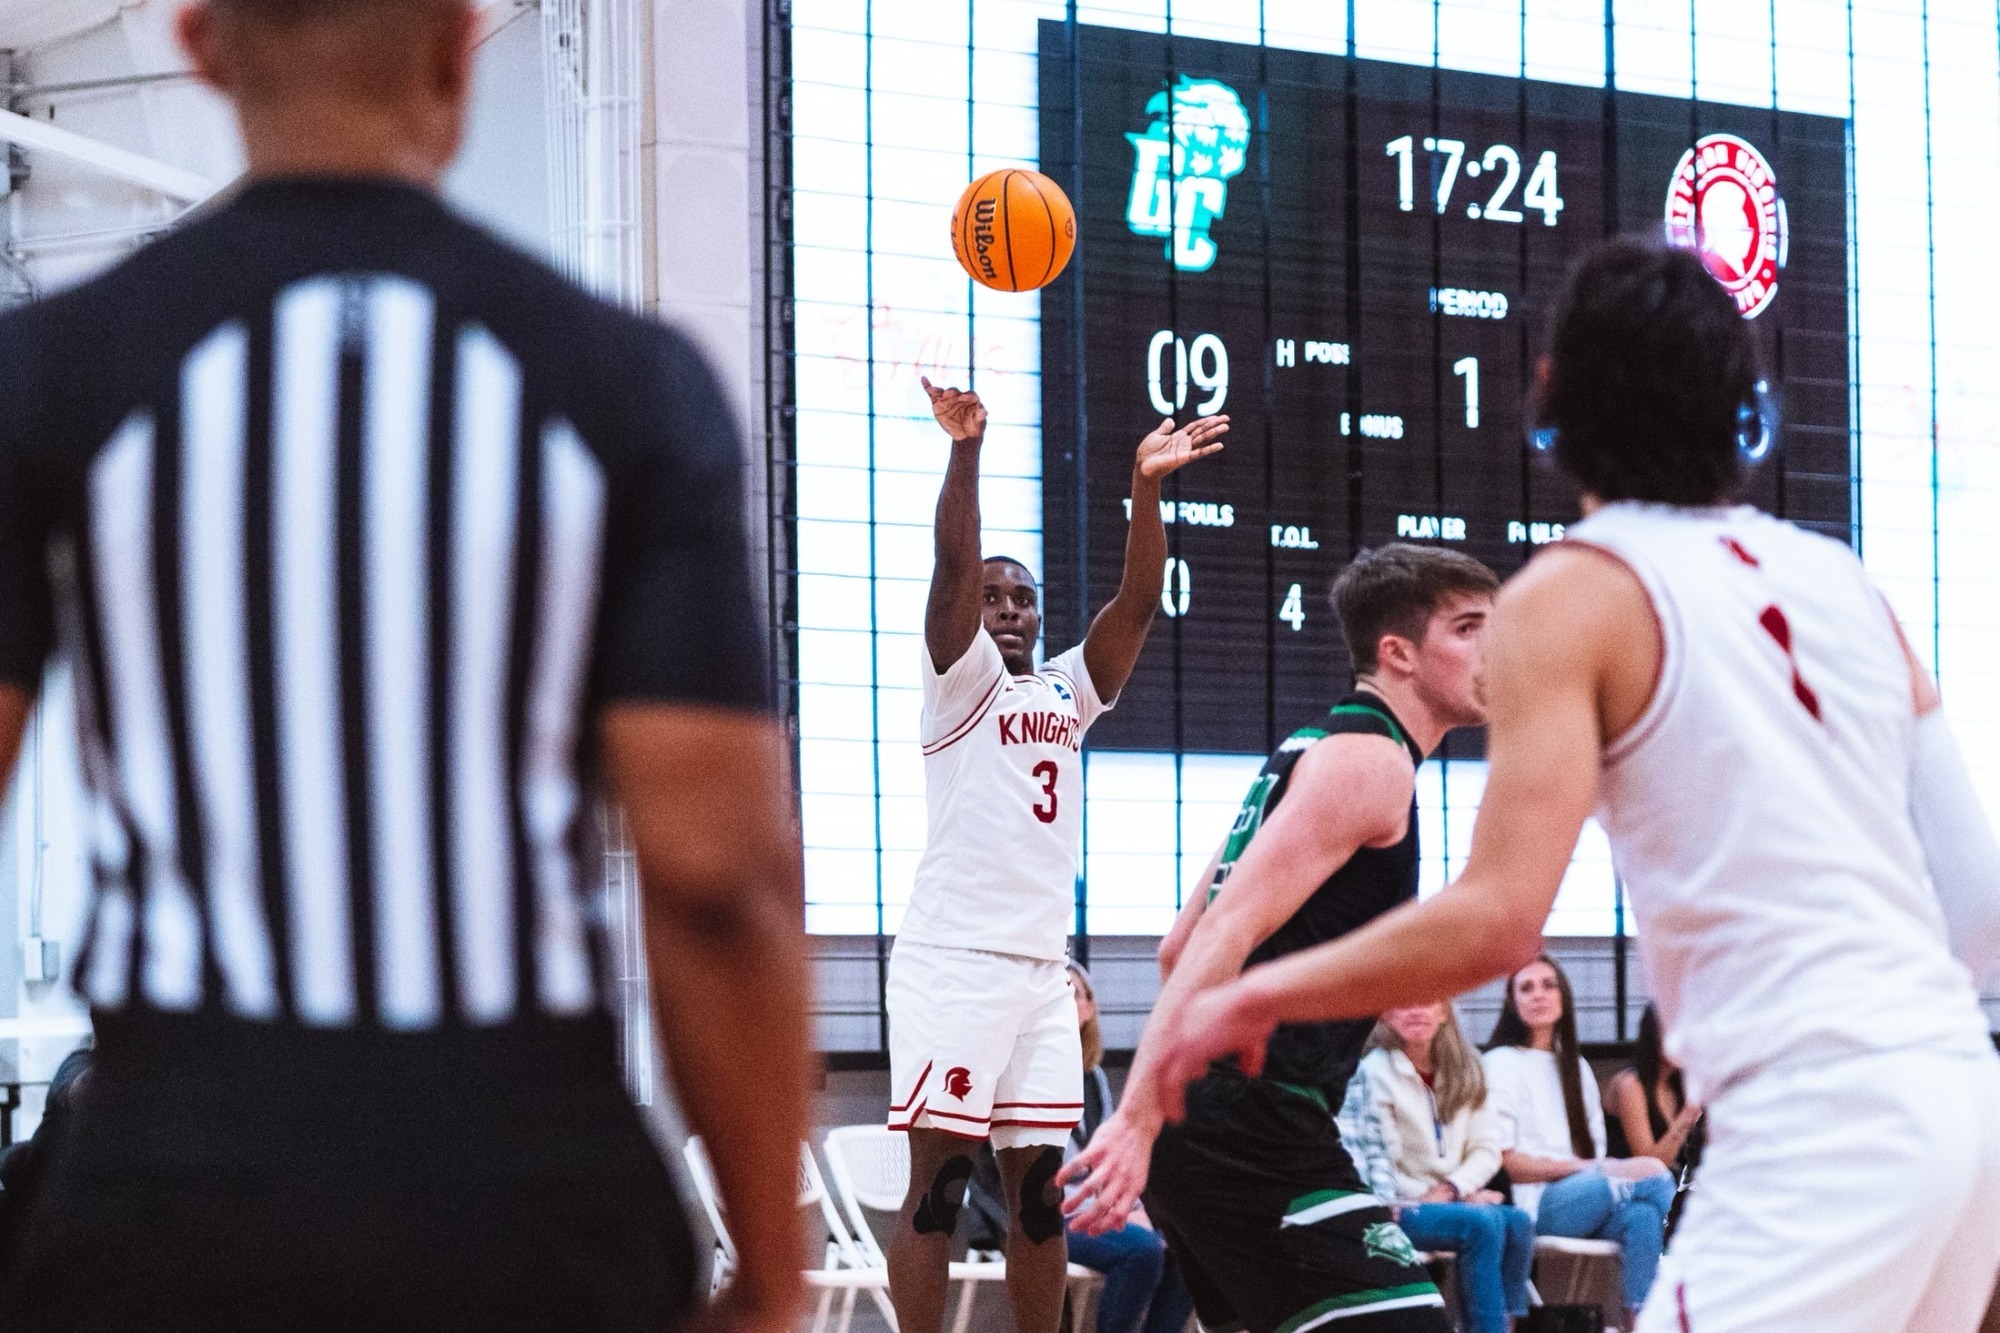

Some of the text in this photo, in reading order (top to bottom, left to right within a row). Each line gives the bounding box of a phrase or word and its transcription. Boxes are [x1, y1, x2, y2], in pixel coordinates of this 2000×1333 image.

[1386, 134, 1565, 227] 17:24
[974, 197, 997, 279] Wilson
[1147, 329, 1229, 417] 09
[1276, 338, 1295, 368] H
[1453, 356, 1479, 429] 1
[1161, 557, 1191, 618] 0
[1278, 583, 1306, 632] 4
[1032, 760, 1059, 824] 3
